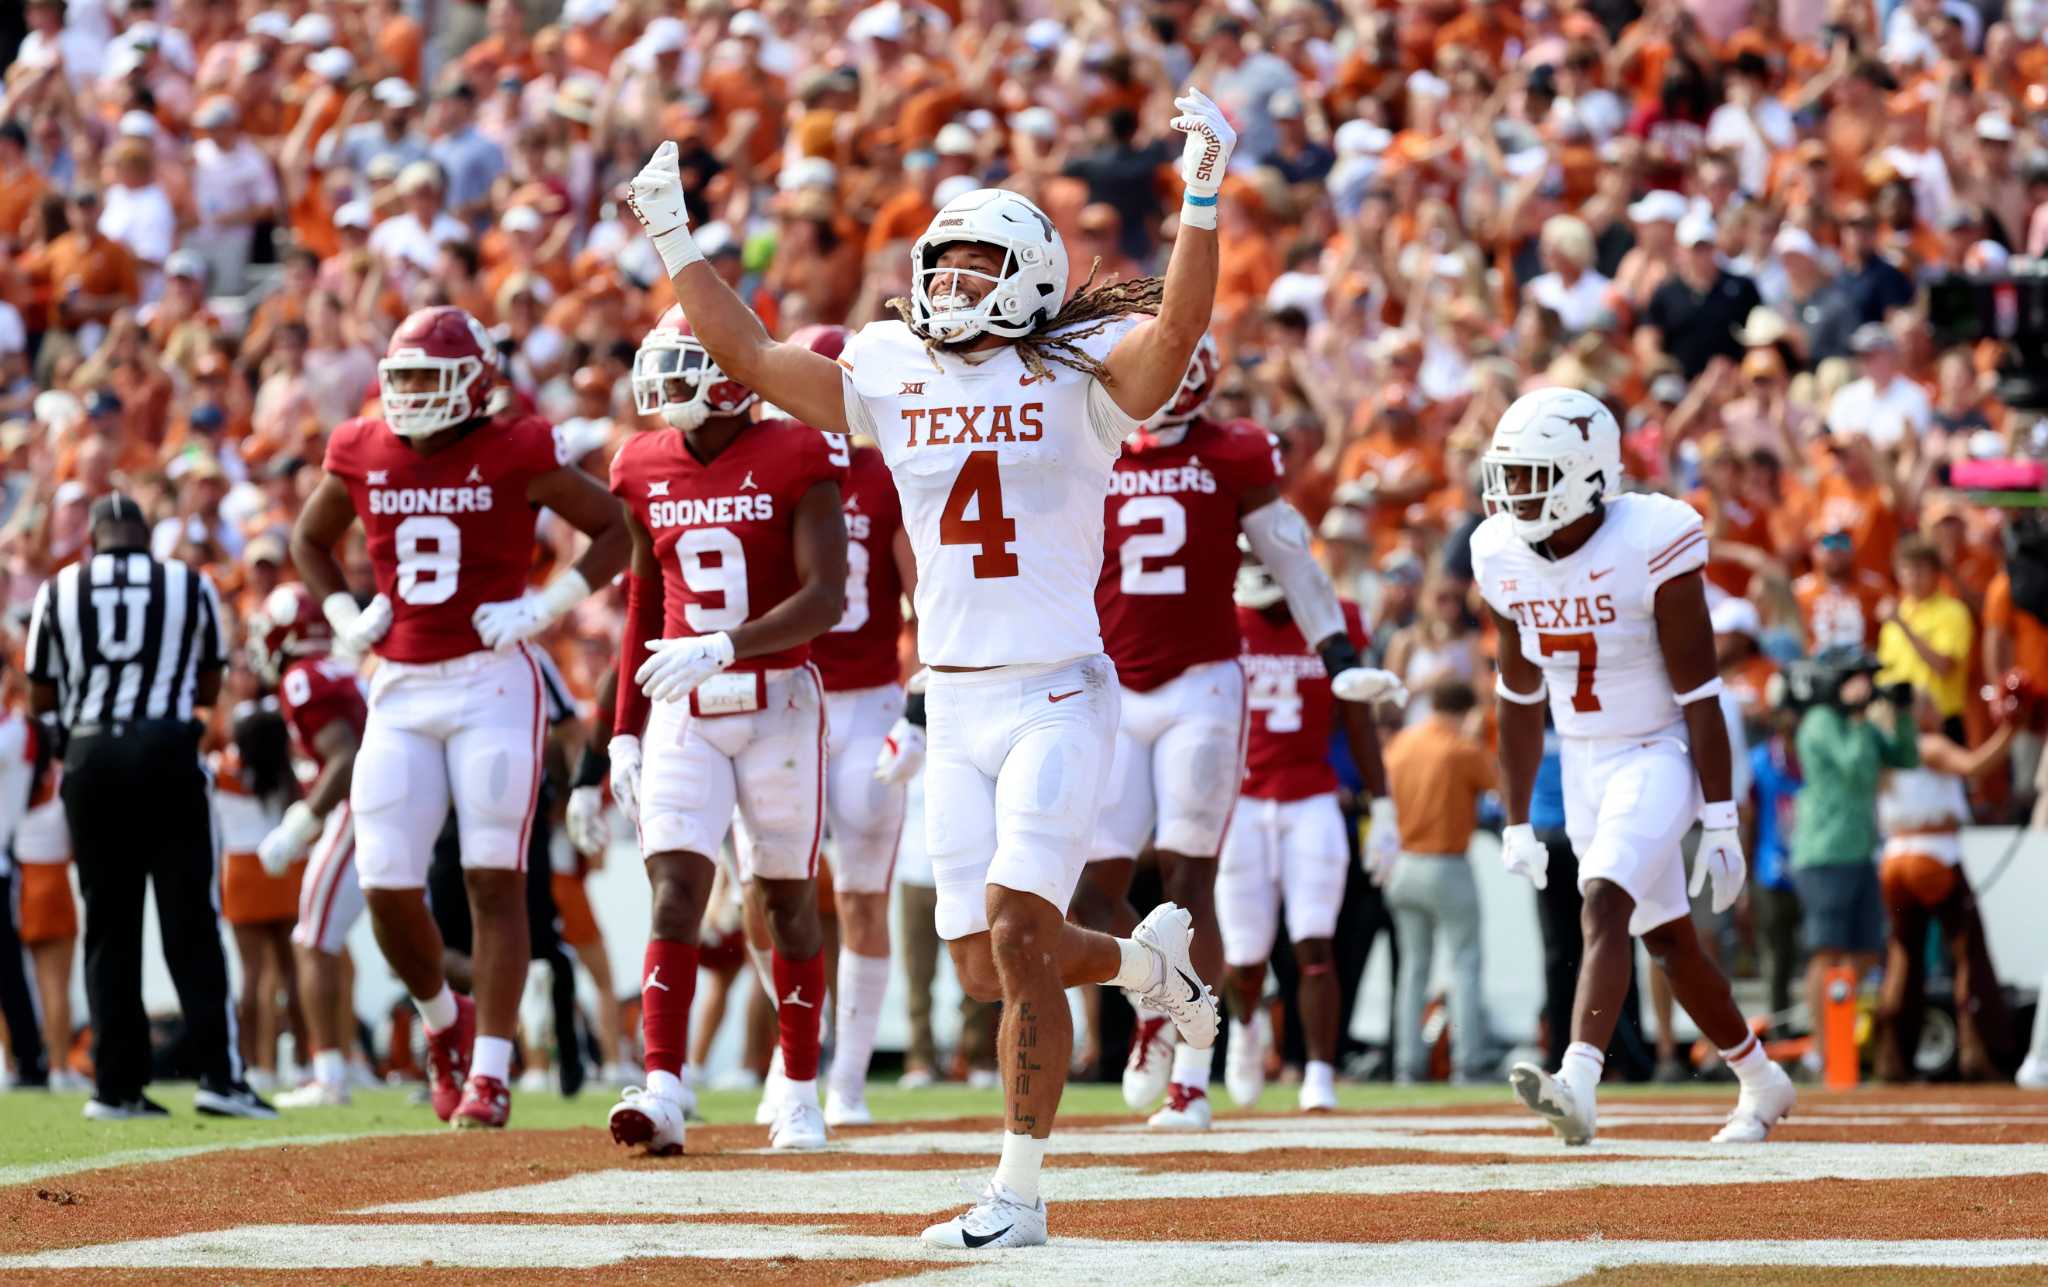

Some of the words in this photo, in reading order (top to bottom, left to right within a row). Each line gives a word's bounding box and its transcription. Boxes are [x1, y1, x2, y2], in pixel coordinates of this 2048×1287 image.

[1177, 120, 1221, 182] LONGHORNS
[898, 381, 927, 396] XII
[820, 430, 850, 467] 9
[901, 402, 1044, 448] TEXAS
[369, 485, 493, 515] SOONERS
[1106, 465, 1217, 496] OONERS
[649, 493, 774, 528] SOONERS
[940, 450, 1019, 579] 4
[395, 515, 461, 605] 8
[1117, 496, 1187, 595] 2
[675, 527, 750, 633] 9
[91, 586, 150, 662] U
[1508, 594, 1617, 629] TEXAS
[1538, 631, 1602, 713] 7
